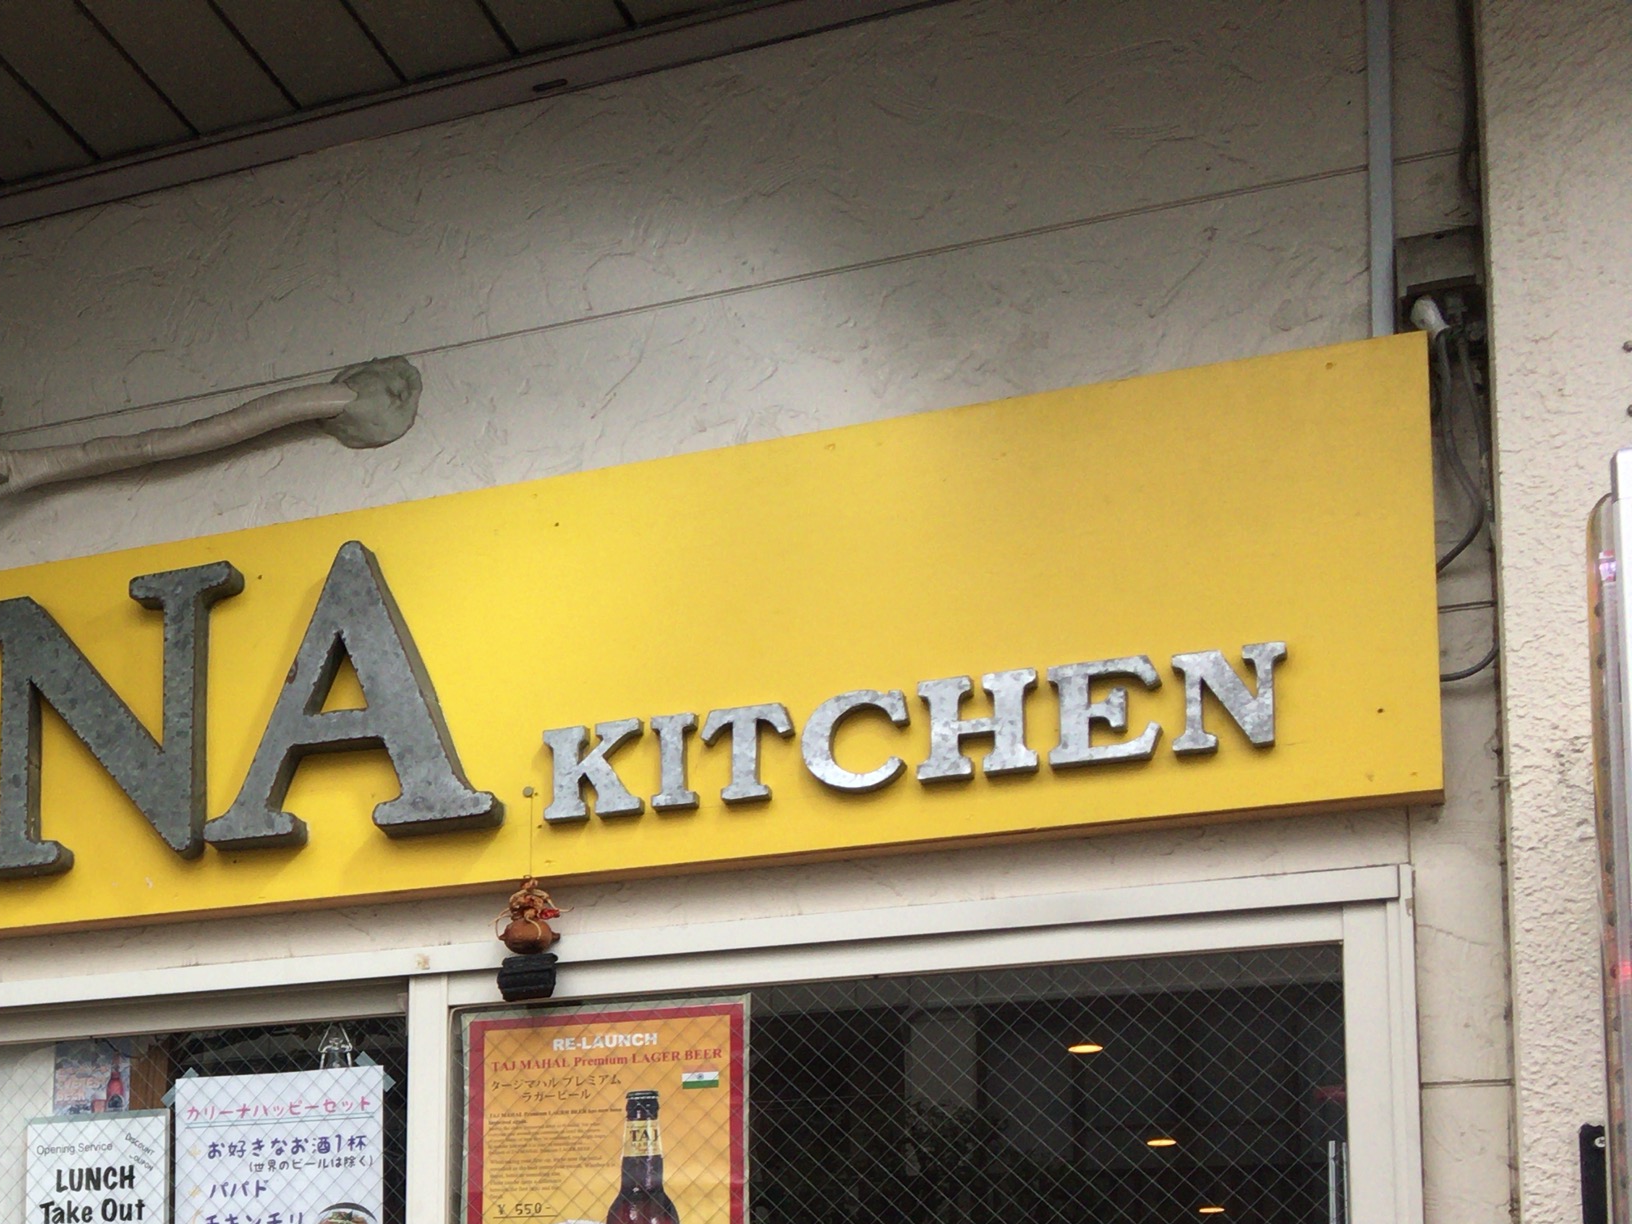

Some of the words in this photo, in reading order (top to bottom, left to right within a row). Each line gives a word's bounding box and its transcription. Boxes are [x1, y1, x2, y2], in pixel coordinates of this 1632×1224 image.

[542, 641, 1287, 824] KITCHEN
[552, 1032, 658, 1052] RE-LAUNCH
[491, 1060, 517, 1073] TAJ
[520, 1058, 569, 1071] MAHAL
[574, 1055, 628, 1067] Premium
[631, 1051, 681, 1064] LAGER
[684, 1048, 722, 1061] BEER
[491, 1075, 559, 1091] タージマハル
[562, 1073, 622, 1087] プレミアム
[521, 1089, 591, 1103] ラガービール
[186, 1096, 370, 1121] カリーナハッピーセット
[125, 1133, 156, 1156] DISCOUNT
[207, 1133, 368, 1160] お好きなお酒1杯
[630, 1129, 659, 1143] TAJ
[36, 1144, 76, 1156] Opening
[77, 1143, 113, 1153] Service
[56, 1165, 136, 1193] LUNCH
[209, 1179, 269, 1199] パパド
[39, 1200, 94, 1224] Take
[101, 1198, 145, 1222] Out
